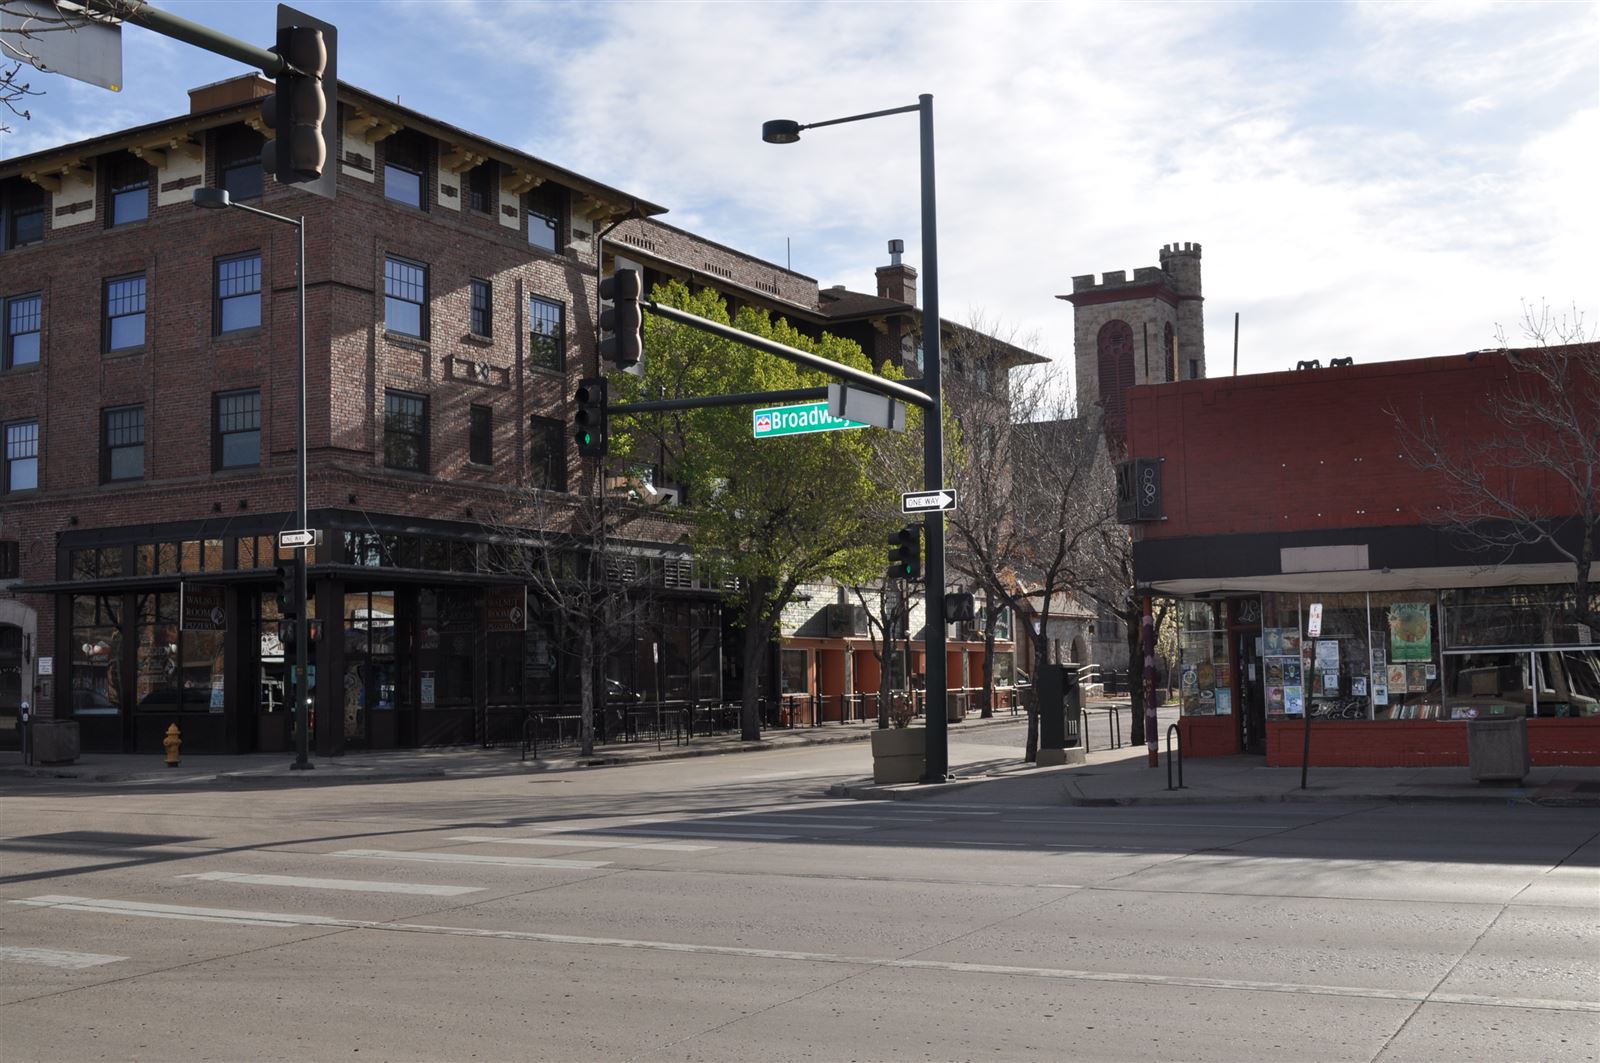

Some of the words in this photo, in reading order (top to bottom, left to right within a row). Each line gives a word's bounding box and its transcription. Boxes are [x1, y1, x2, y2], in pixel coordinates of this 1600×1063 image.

[908, 498, 923, 507] ONE
[925, 497, 940, 505] WAY
[186, 607, 210, 617] ROOM
